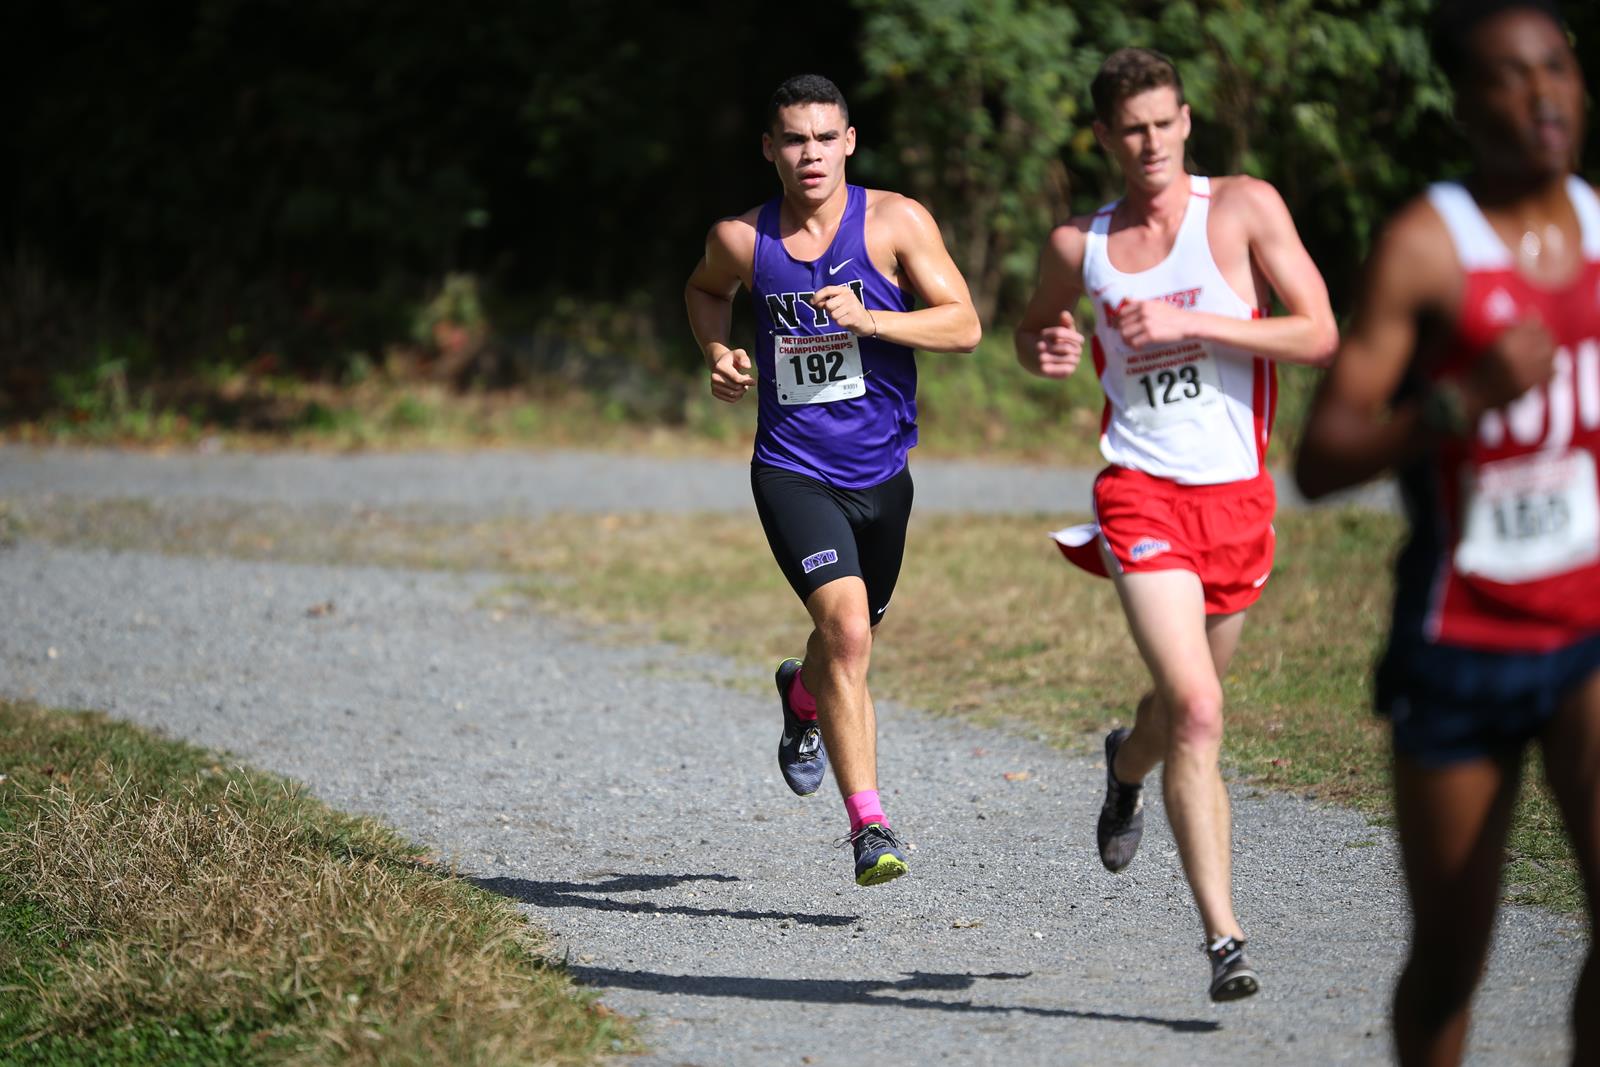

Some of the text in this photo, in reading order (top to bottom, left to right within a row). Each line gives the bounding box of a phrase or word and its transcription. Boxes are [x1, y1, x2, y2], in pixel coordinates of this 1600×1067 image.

[779, 341, 853, 354] CHAMPIONSHIPS
[781, 333, 849, 344] METROPOLITAN
[789, 351, 847, 385] 192
[1139, 364, 1201, 408] 123
[803, 550, 837, 572] NYU
